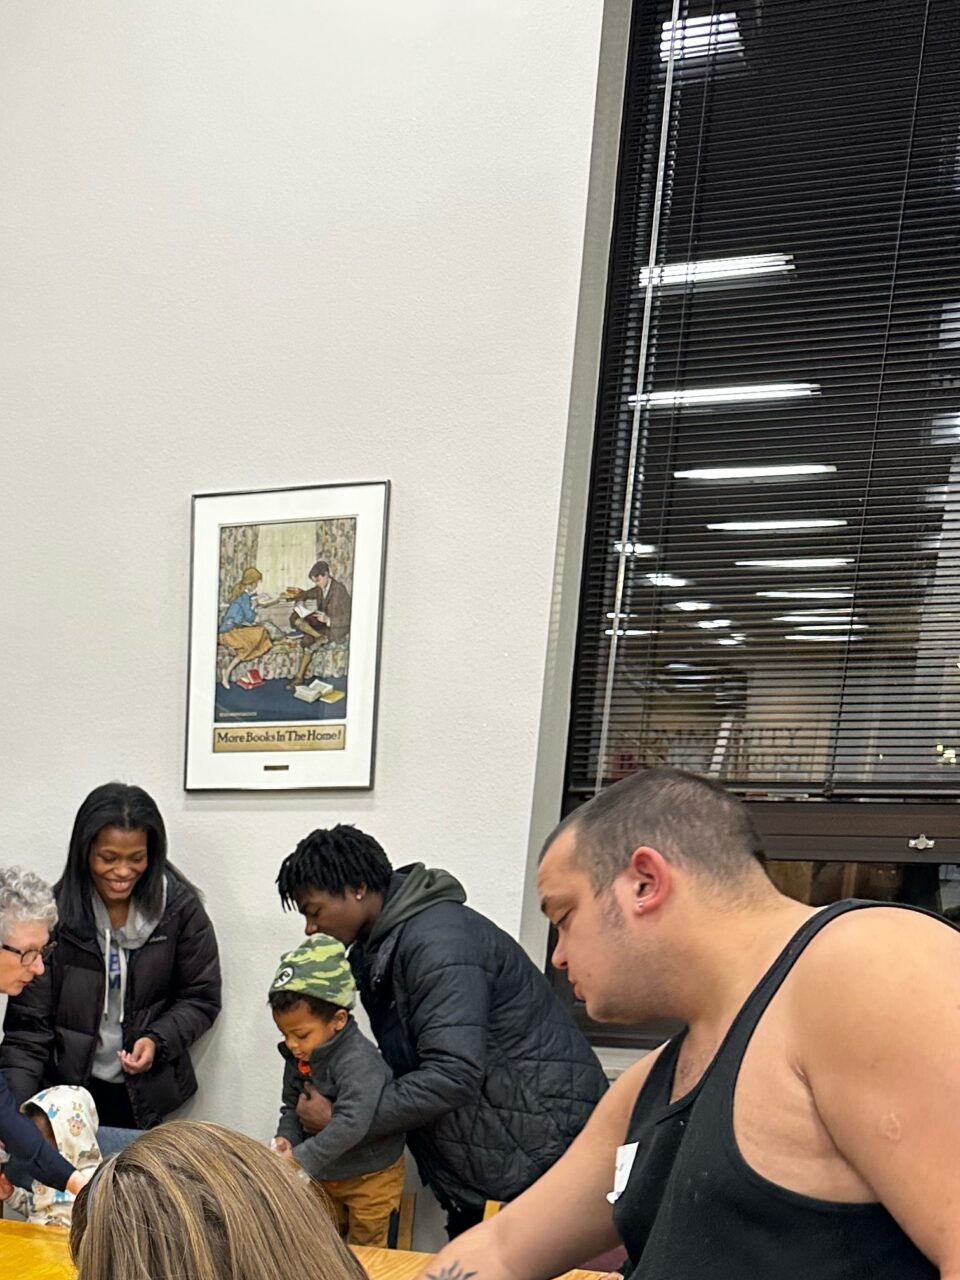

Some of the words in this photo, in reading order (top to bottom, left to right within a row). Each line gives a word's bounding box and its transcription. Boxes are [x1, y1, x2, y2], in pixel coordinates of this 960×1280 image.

[216, 732, 245, 744] More
[246, 731, 275, 743] Books
[276, 731, 286, 742] In
[286, 730, 307, 742] The
[307, 729, 341, 742] Home!
